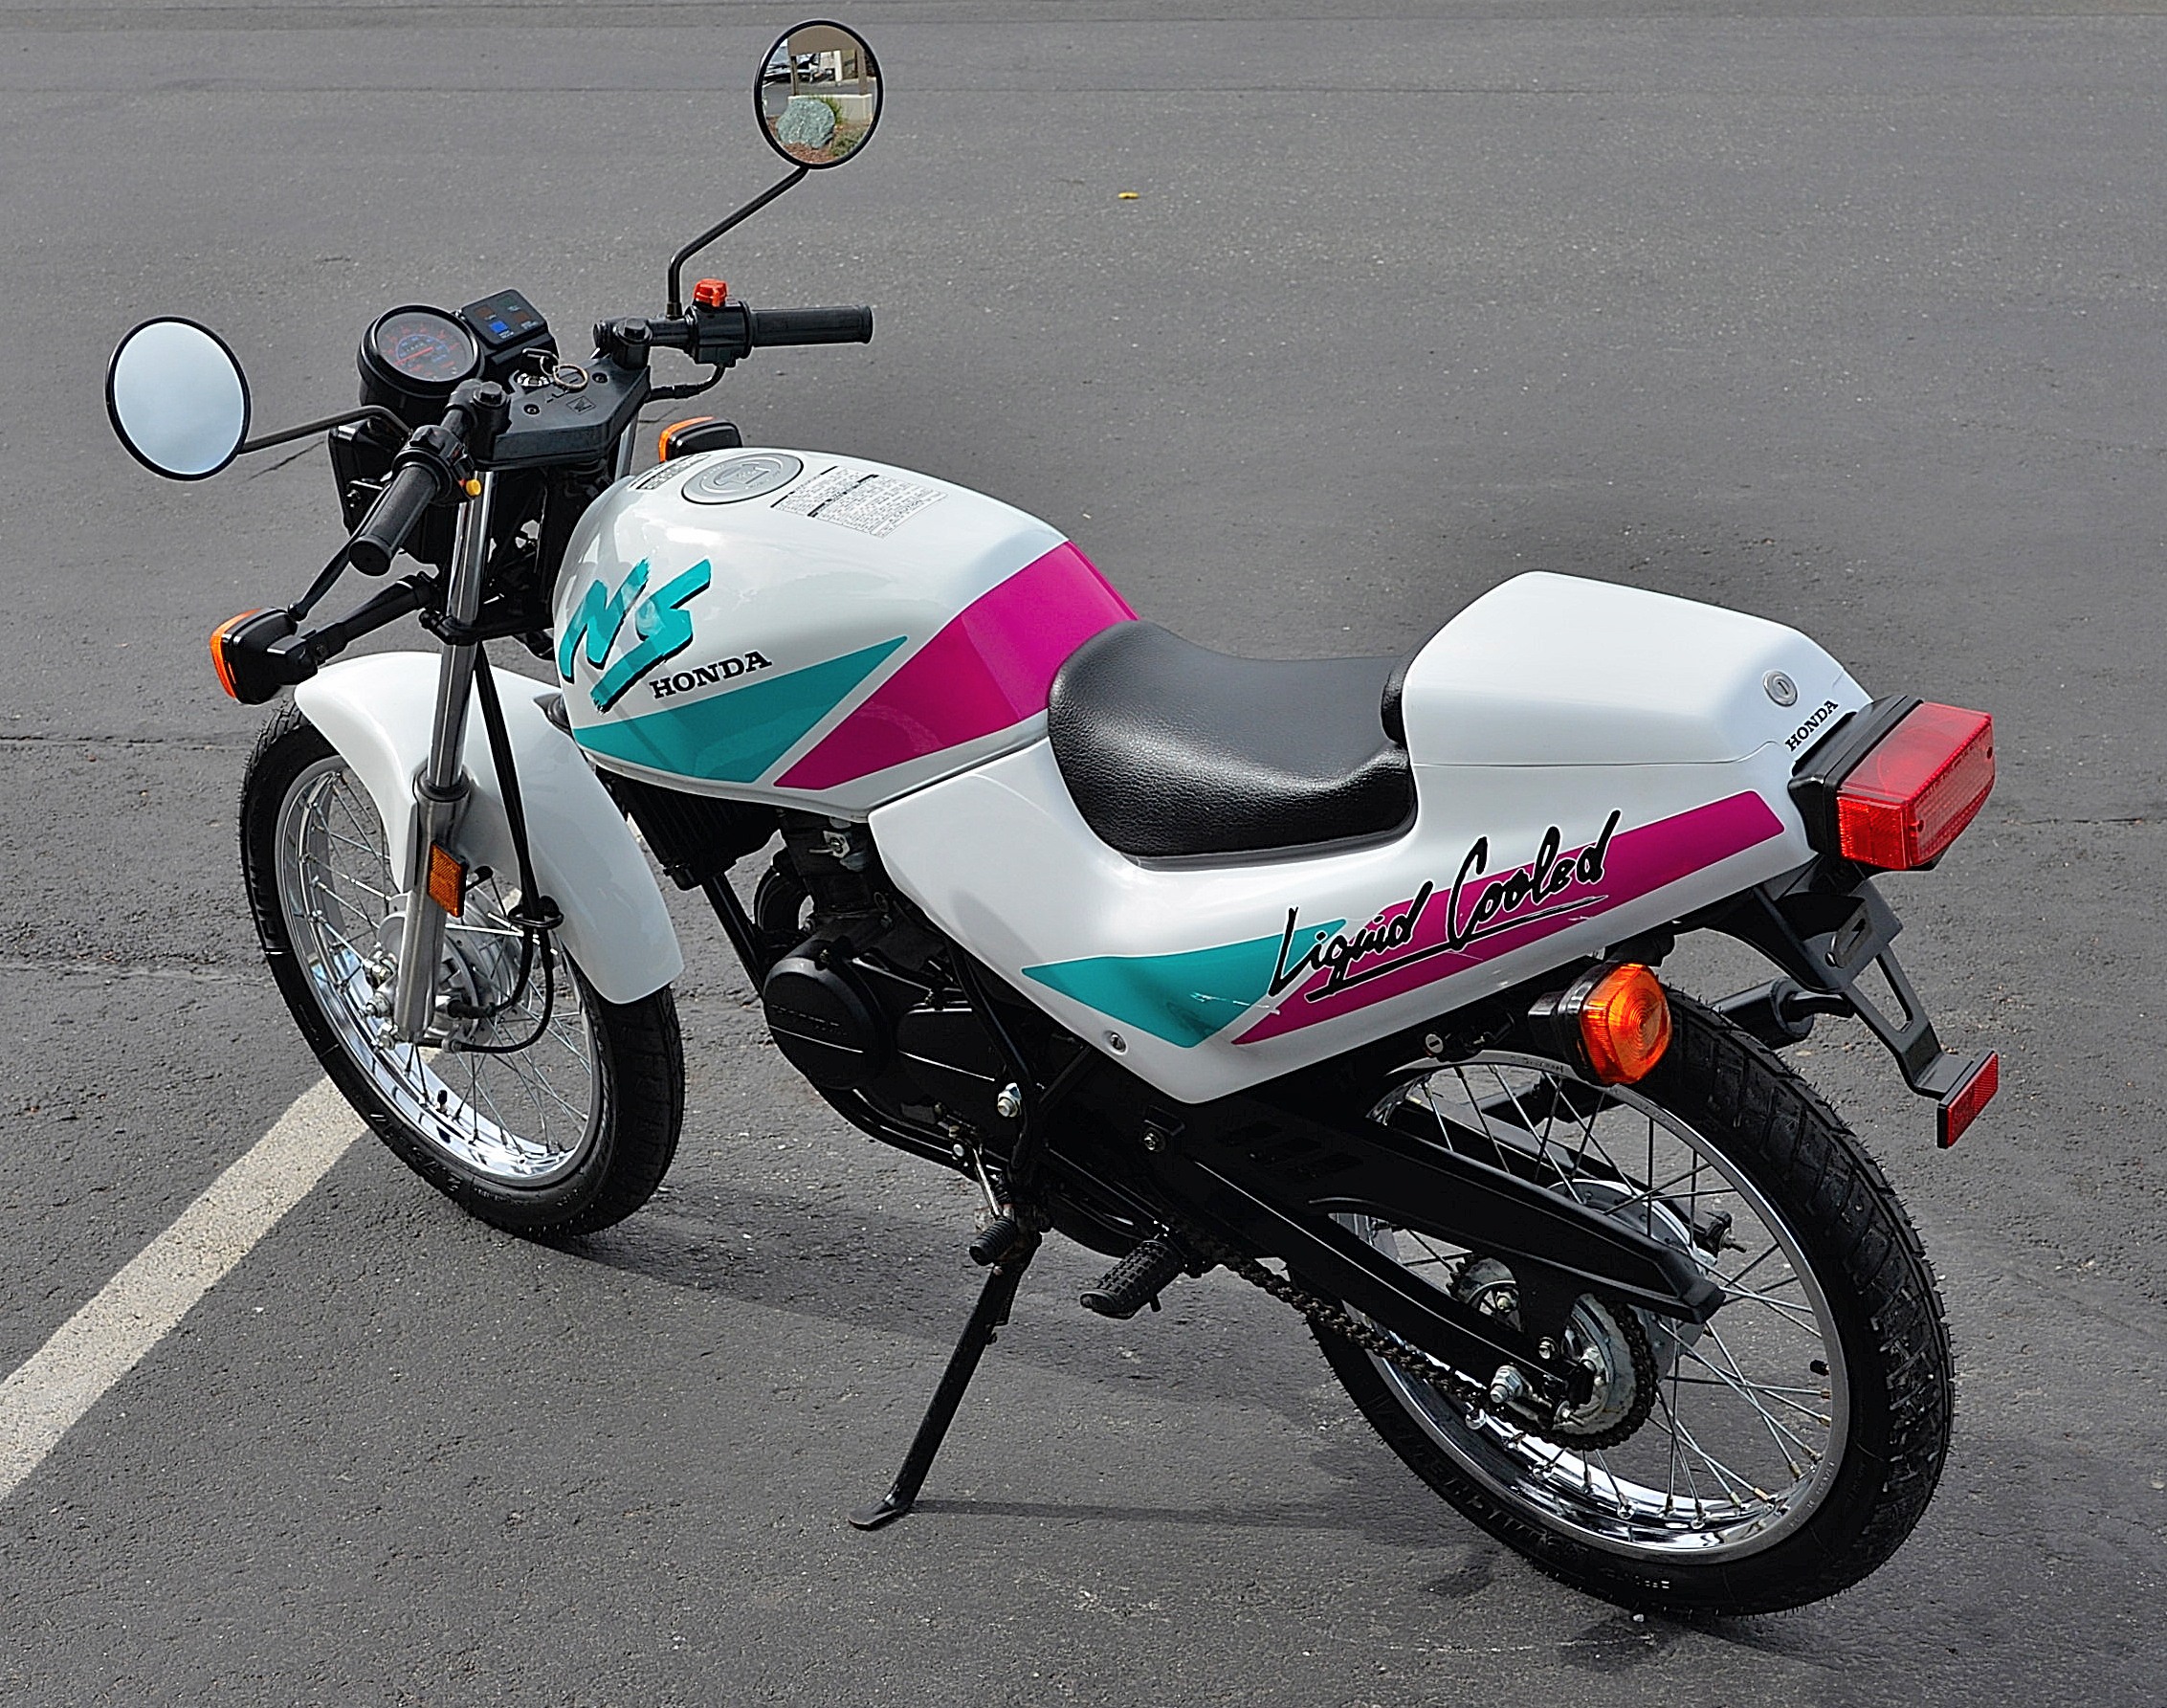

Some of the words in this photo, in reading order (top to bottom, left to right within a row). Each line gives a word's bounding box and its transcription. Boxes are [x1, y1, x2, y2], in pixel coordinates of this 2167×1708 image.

[558, 557, 712, 715] NS
[650, 651, 772, 699] HONDA
[1785, 699, 1839, 752] HONDA
[1269, 880, 1433, 1003] Liquid
[1448, 810, 1622, 947] Cooled
